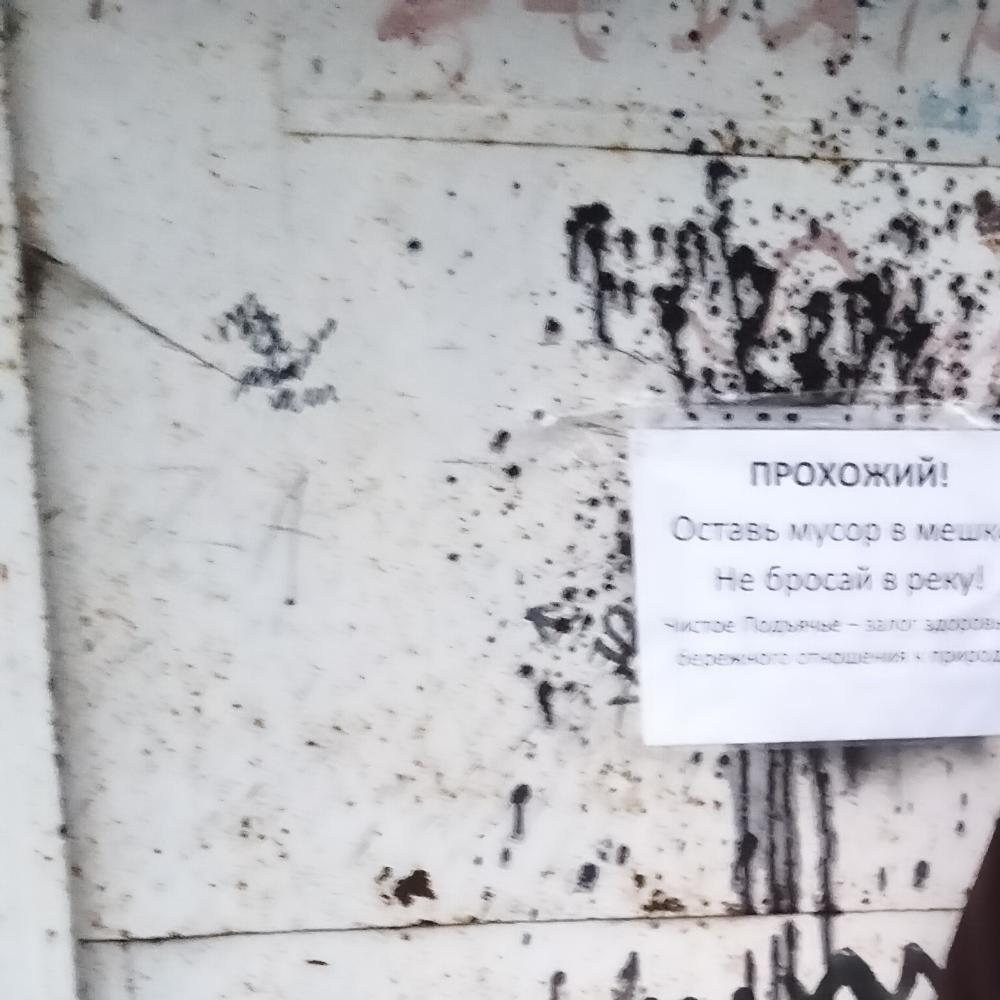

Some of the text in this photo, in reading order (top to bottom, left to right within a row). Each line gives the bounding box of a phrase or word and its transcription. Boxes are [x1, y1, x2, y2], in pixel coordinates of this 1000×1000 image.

[750, 456, 949, 488] ПРОХОЖИЙ!
[671, 515, 780, 543] Оставь
[788, 520, 882, 548] мусор
[892, 521, 907, 543] в
[715, 564, 984, 597] Не бросай в реку!
[676, 649, 790, 669] бережного
[797, 649, 906, 667] отношения
